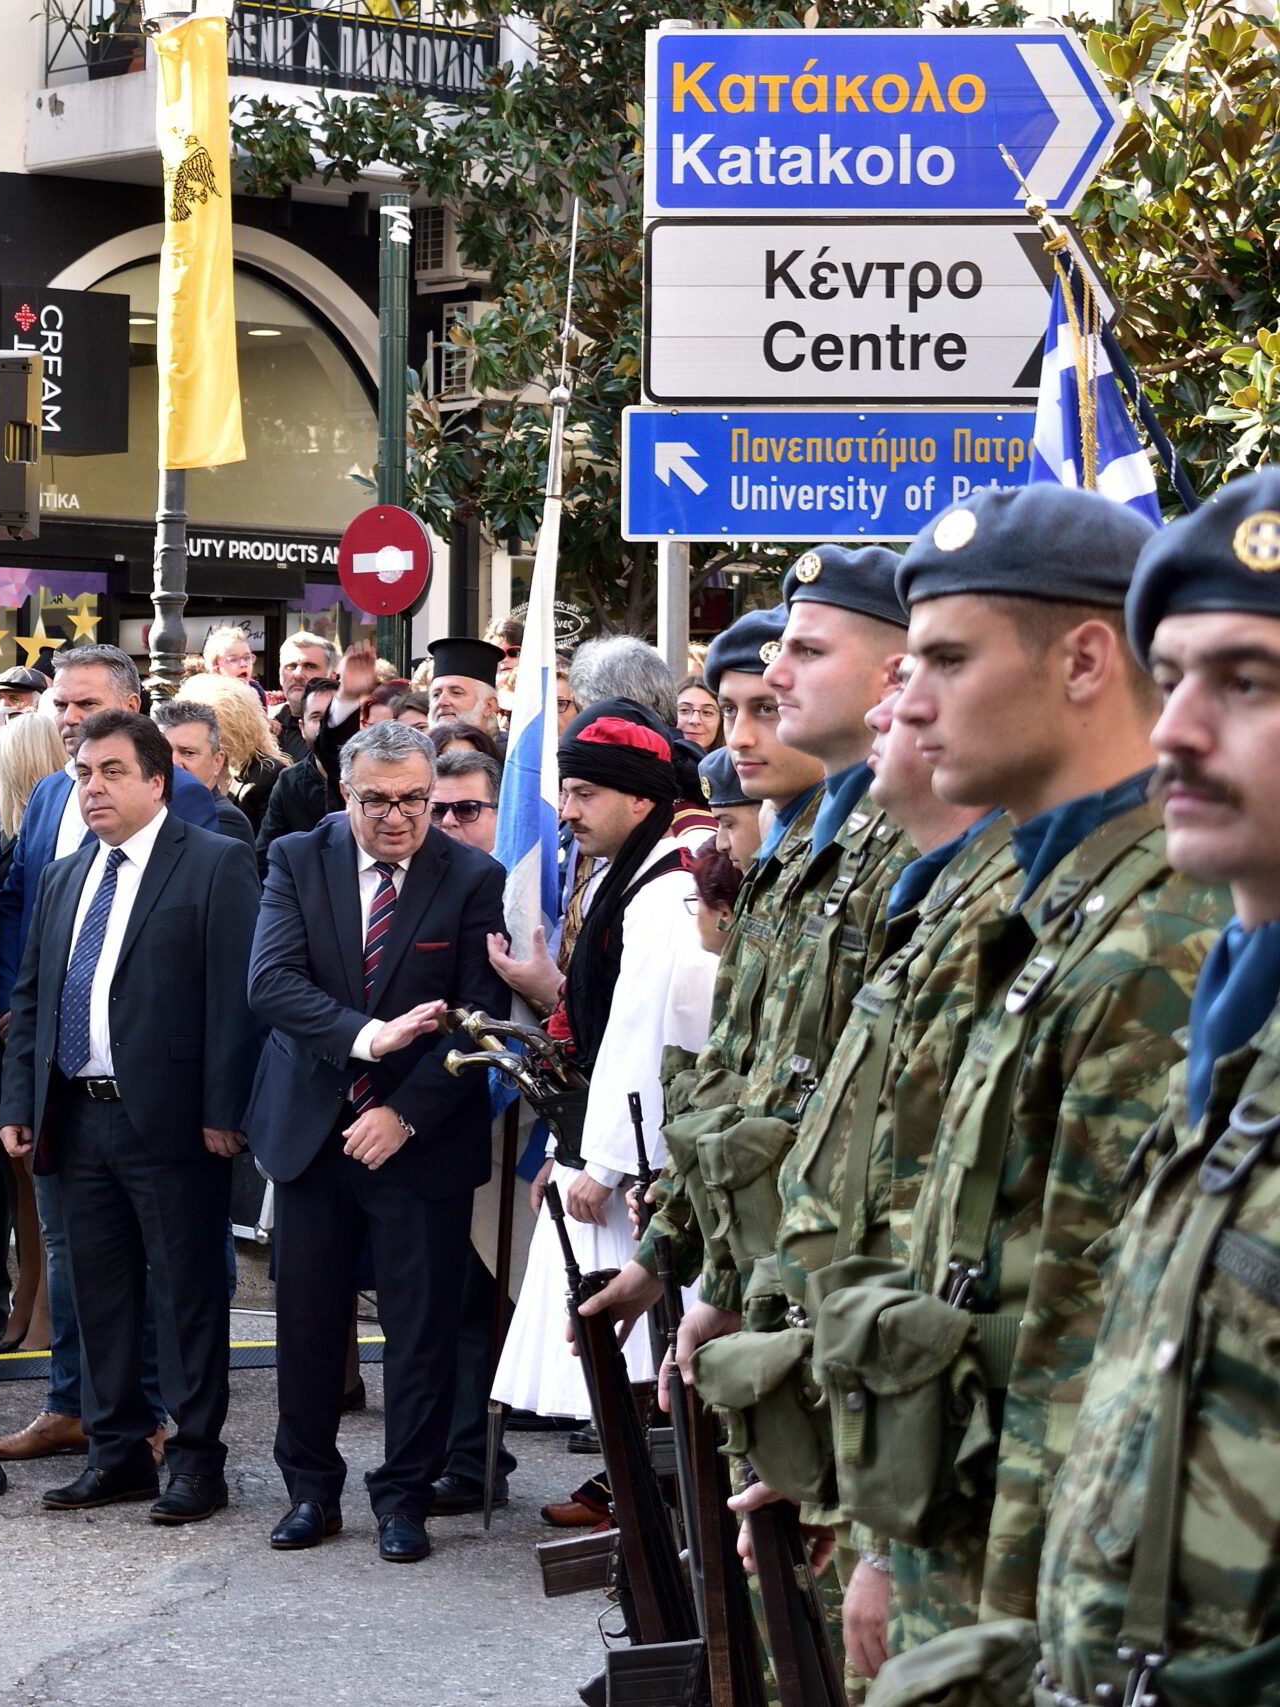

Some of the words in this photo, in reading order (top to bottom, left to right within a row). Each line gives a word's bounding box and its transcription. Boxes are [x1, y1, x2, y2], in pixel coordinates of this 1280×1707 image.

[228, 11, 294, 71] ΛΕΝΗ
[672, 58, 986, 113] Κατάκολο
[672, 134, 956, 186] Katakolo
[765, 246, 982, 313] Κέντρο
[763, 320, 967, 372] Centre
[731, 428, 936, 472] Πανεπιστήμιο
[731, 475, 887, 520] University
[905, 476, 935, 511] of
[228, 540, 318, 563] PRODUCTS
